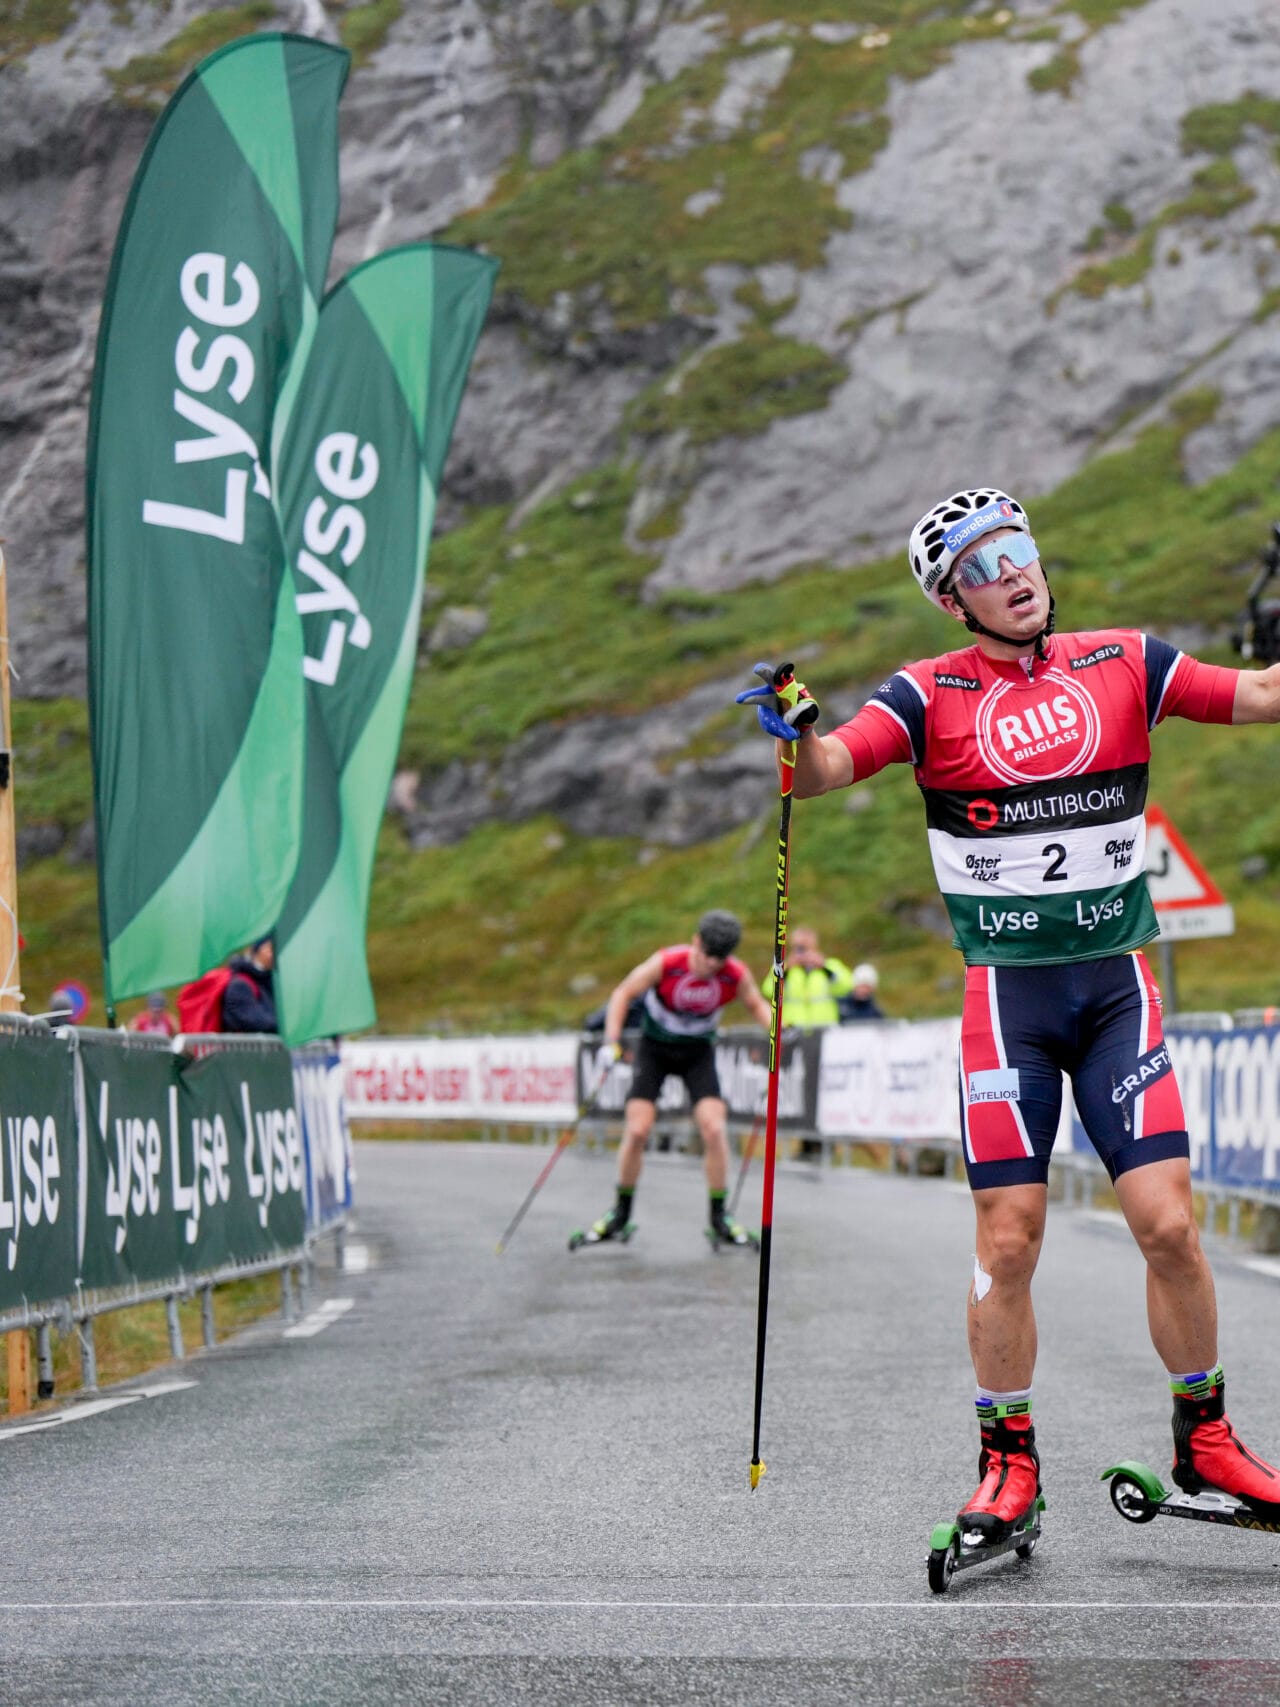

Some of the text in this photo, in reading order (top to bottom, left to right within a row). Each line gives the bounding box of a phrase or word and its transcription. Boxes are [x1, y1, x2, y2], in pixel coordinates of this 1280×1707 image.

[142, 251, 272, 545] Lyse
[946, 509, 1002, 548] SpareBank
[295, 431, 380, 686] Lyse
[1073, 646, 1121, 668] MASIV
[995, 695, 1078, 752] RIIS
[1013, 729, 1081, 762] BILGLASS
[1004, 785, 1126, 823] MULTIBLOKK
[965, 853, 1001, 870] Øster
[1041, 843, 1068, 882] 2
[1104, 838, 1136, 856] Øster
[1113, 853, 1132, 870] Hus
[978, 905, 1040, 938] Lyse
[1076, 897, 1124, 931] Lyse
[1112, 1052, 1169, 1104] CRAFT
[99, 1080, 162, 1254] Lyse
[169, 1085, 231, 1245] Lyse
[241, 1081, 302, 1229] Lyse
